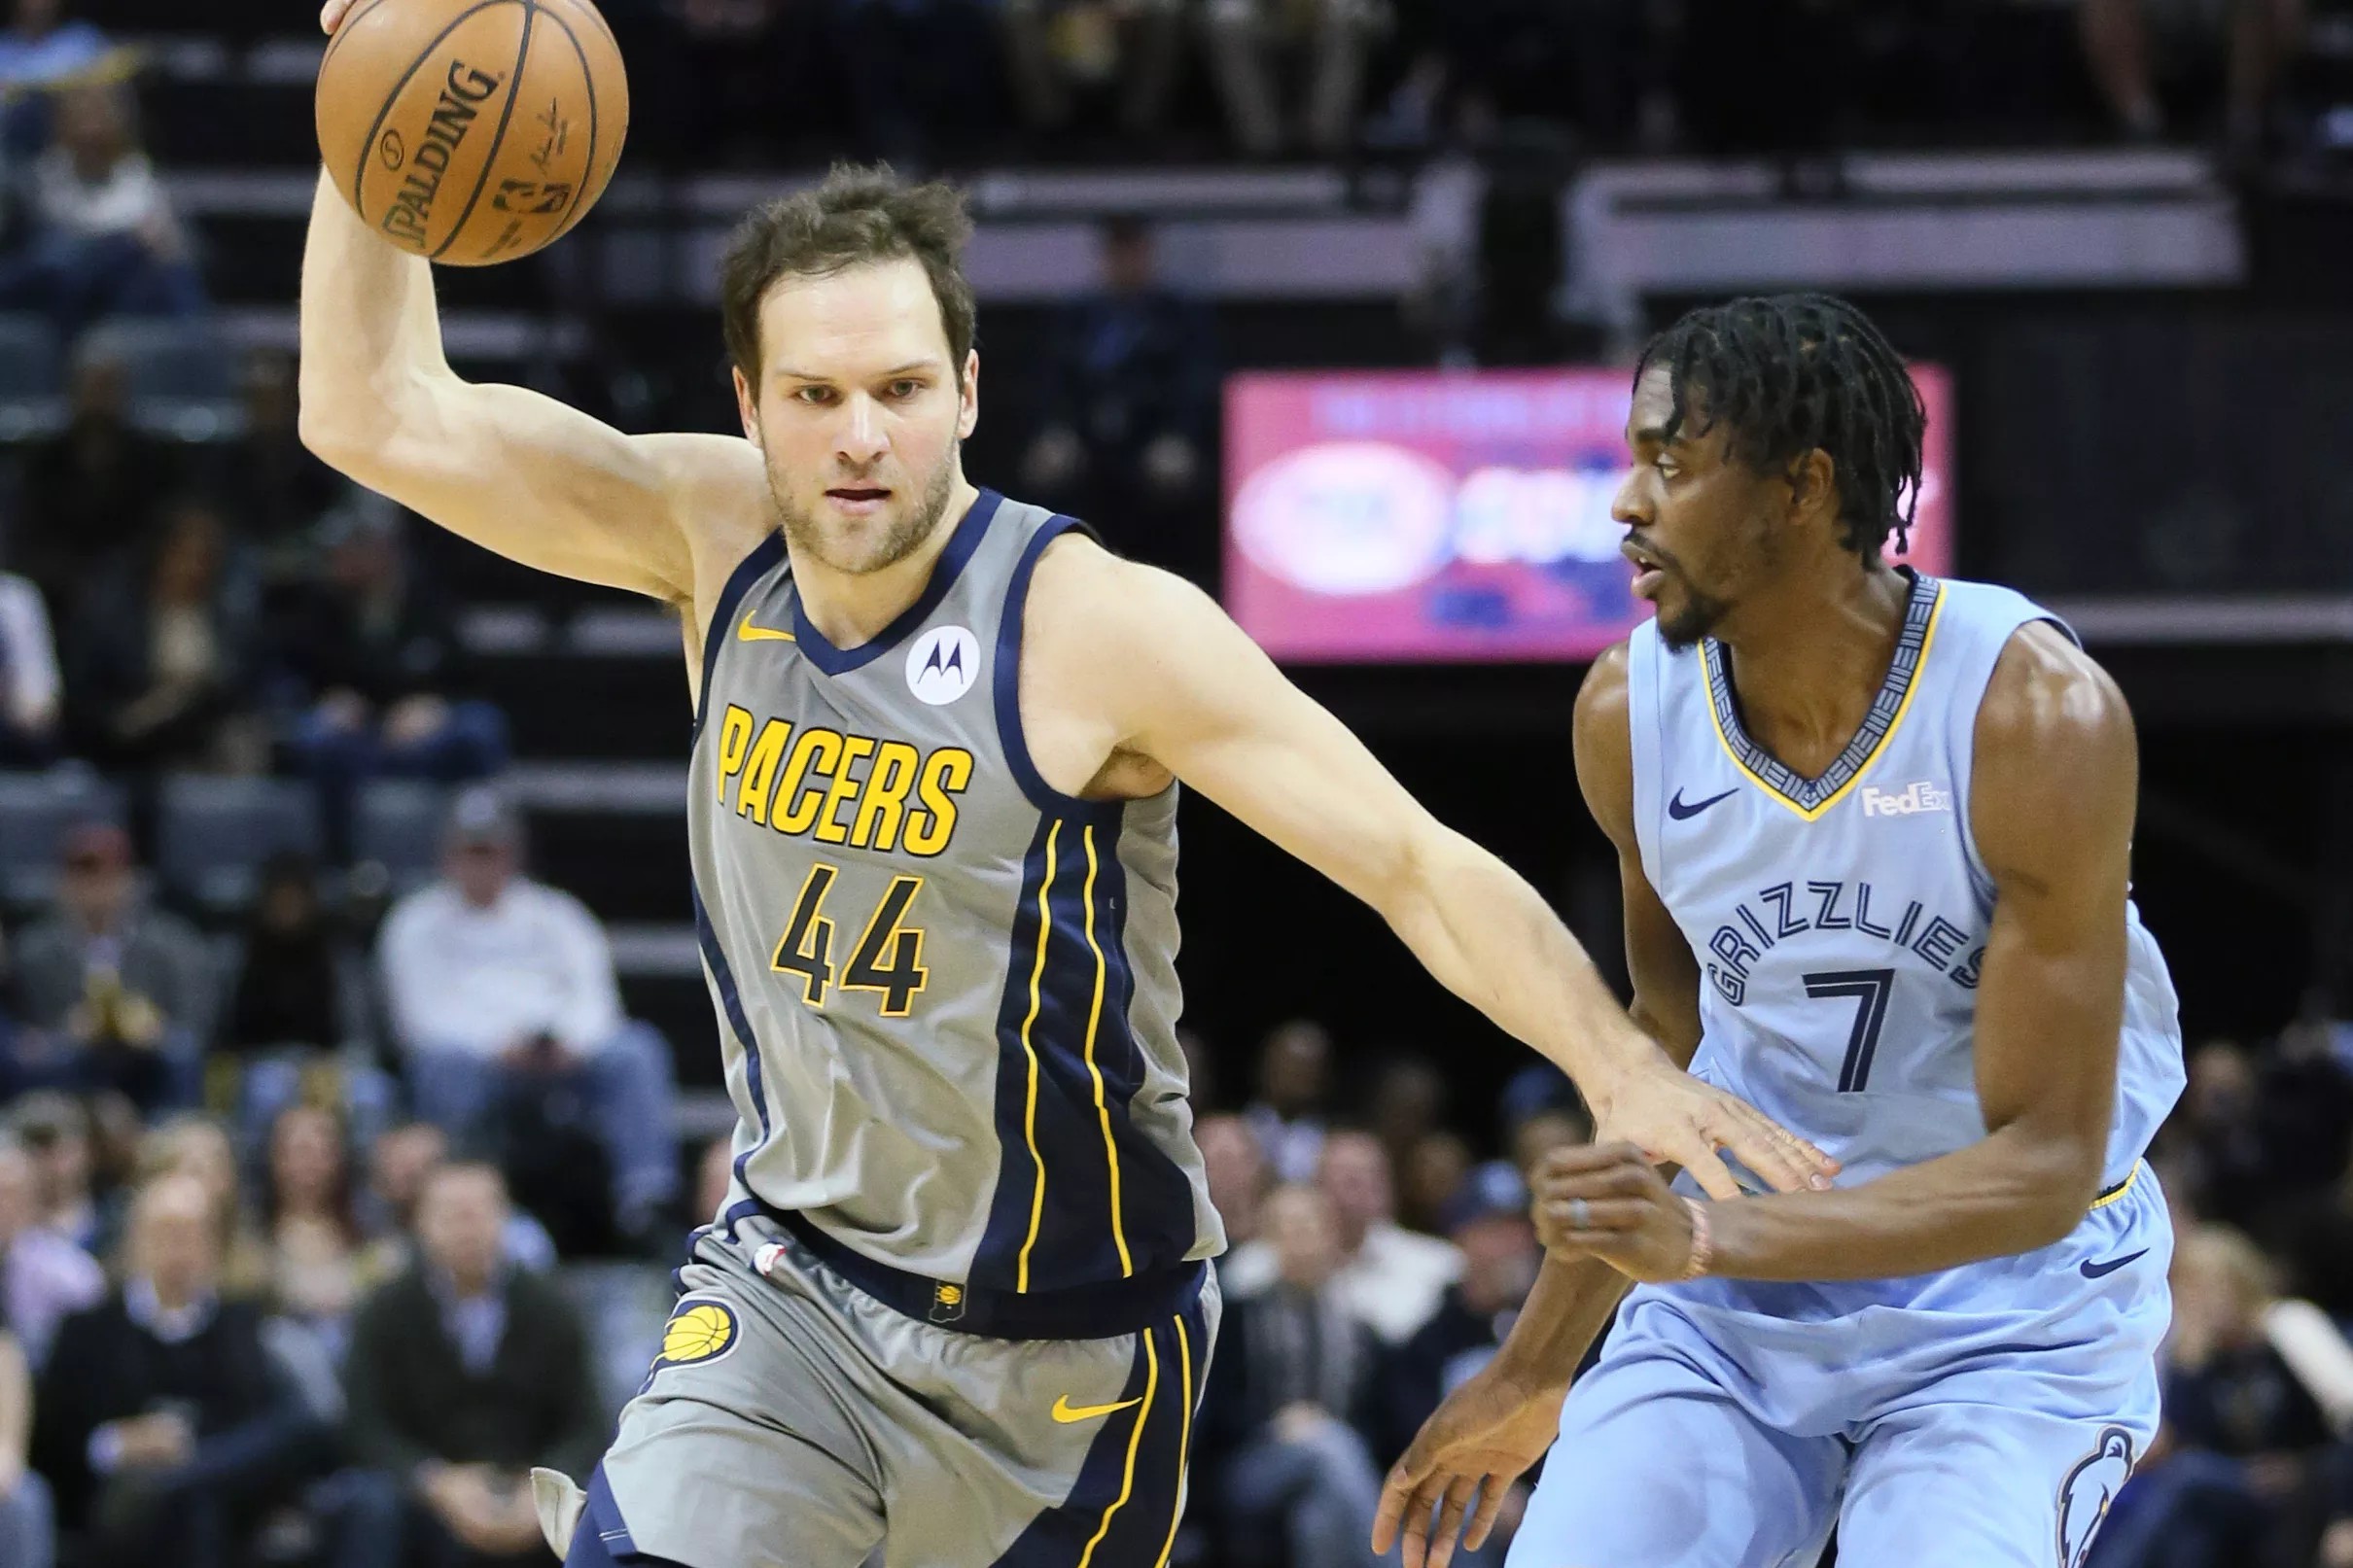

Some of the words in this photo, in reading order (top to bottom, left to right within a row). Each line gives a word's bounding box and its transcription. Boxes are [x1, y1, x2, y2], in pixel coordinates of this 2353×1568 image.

[718, 703, 973, 857] PACERS
[1861, 782, 1951, 818] FedEx
[770, 862, 930, 1018] 44
[1802, 968, 1895, 1093] 7
